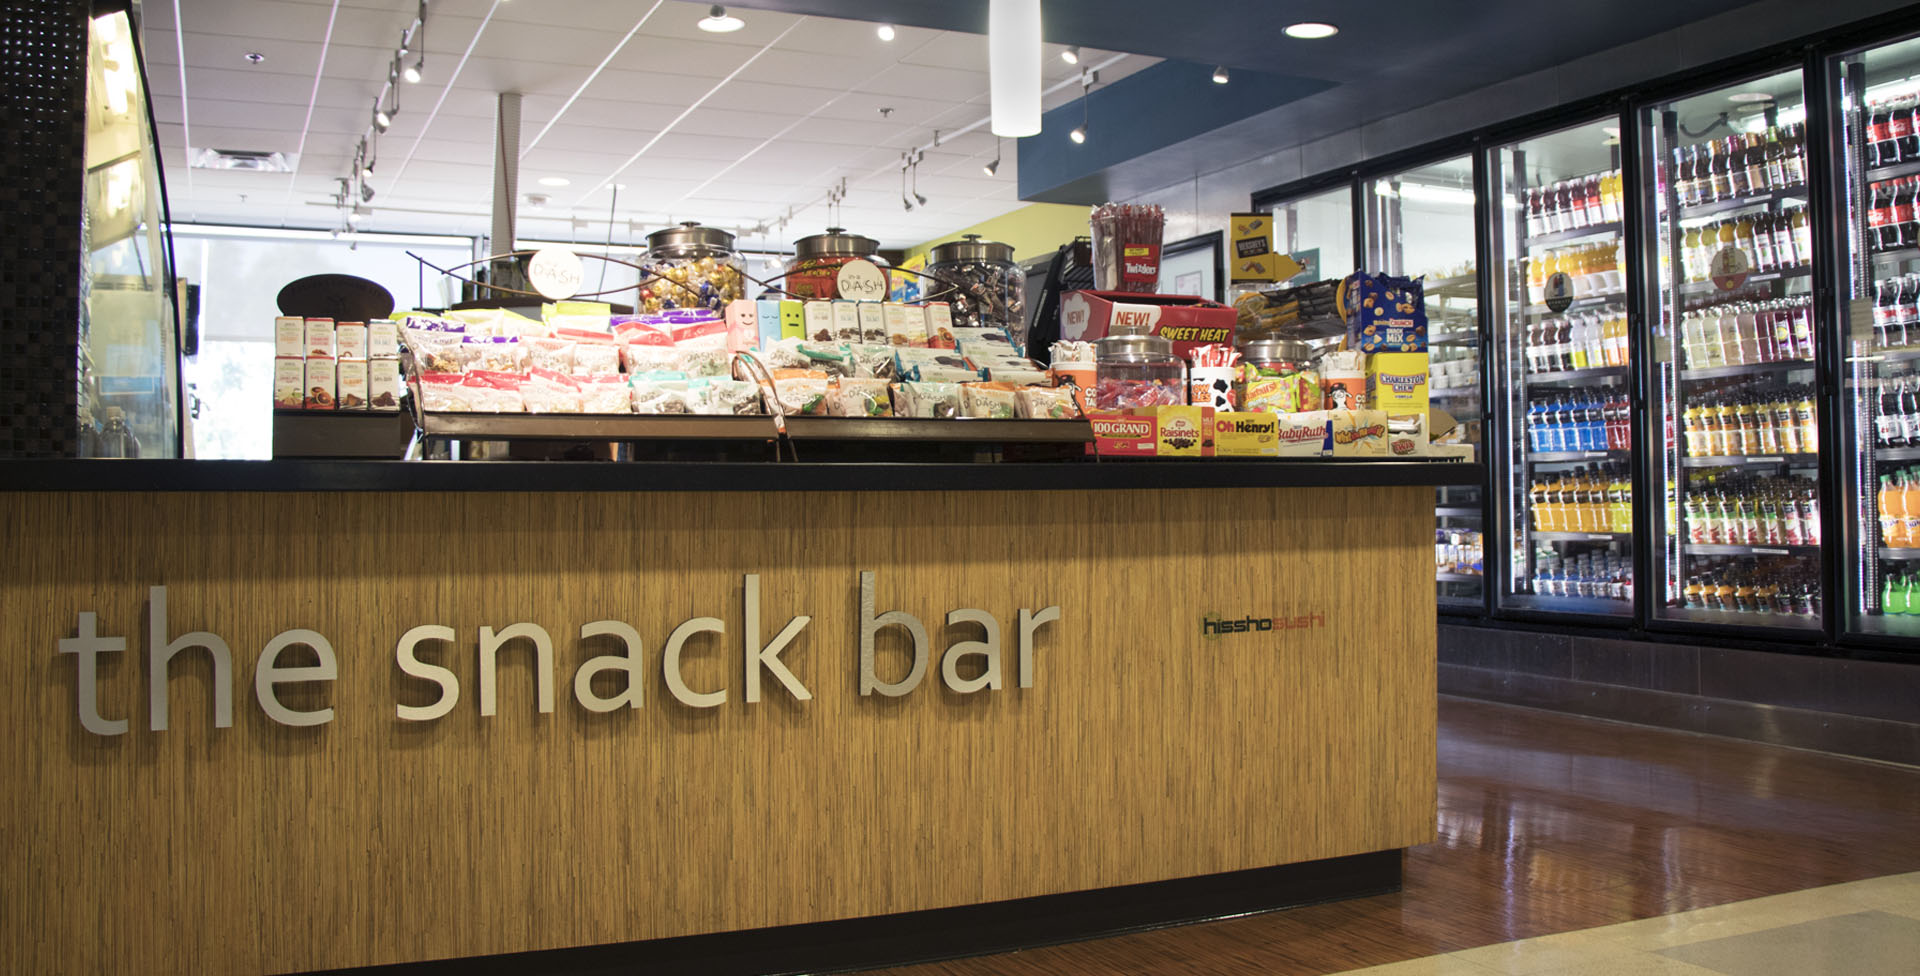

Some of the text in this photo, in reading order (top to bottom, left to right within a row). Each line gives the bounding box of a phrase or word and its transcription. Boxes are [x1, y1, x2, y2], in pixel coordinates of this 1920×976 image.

[1239, 239, 1266, 251] HERSHEY'S
[533, 263, 580, 285] DASH
[841, 278, 884, 294] DASH
[1067, 310, 1085, 325] NEW!
[1115, 311, 1150, 326] NEW!
[1159, 326, 1229, 342] SWEET HEAT
[1381, 374, 1425, 384] CHARLESTON
[1085, 389, 1097, 398] CO
[1394, 384, 1413, 392] CHEW
[976, 398, 1001, 409] DASH
[1355, 394, 1366, 403] CO
[1094, 423, 1149, 433] 100 GRAND
[1160, 427, 1200, 438] Raisinets
[1216, 420, 1234, 433] Oh
[1236, 421, 1275, 433] Henry!
[58, 571, 1060, 736] the snack bar
